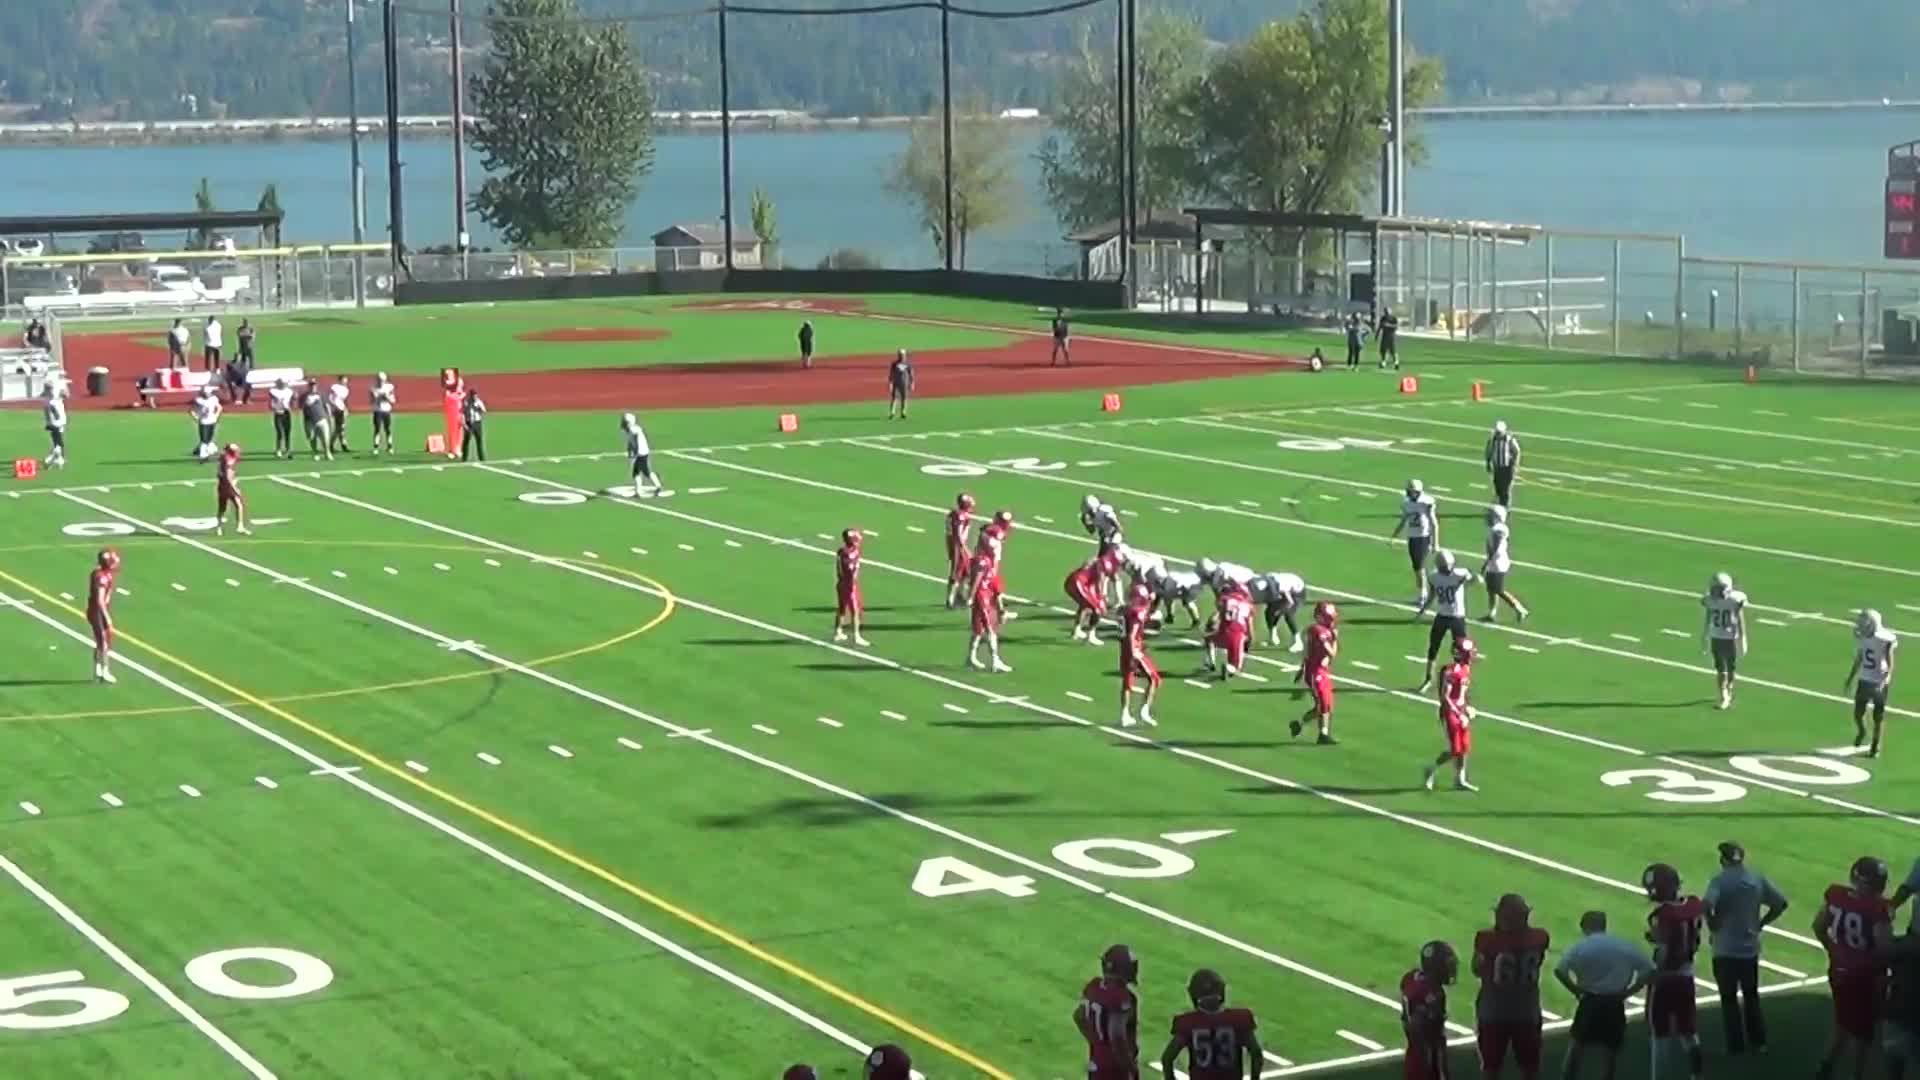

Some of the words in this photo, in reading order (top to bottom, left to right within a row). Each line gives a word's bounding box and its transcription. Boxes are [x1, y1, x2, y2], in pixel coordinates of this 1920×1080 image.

[1712, 609, 1731, 628] 20
[1600, 755, 1871, 802] 30
[912, 838, 1195, 898] 40
[1828, 904, 1868, 951] 78
[0, 947, 334, 1030] 50
[1190, 1026, 1237, 1069] 53
